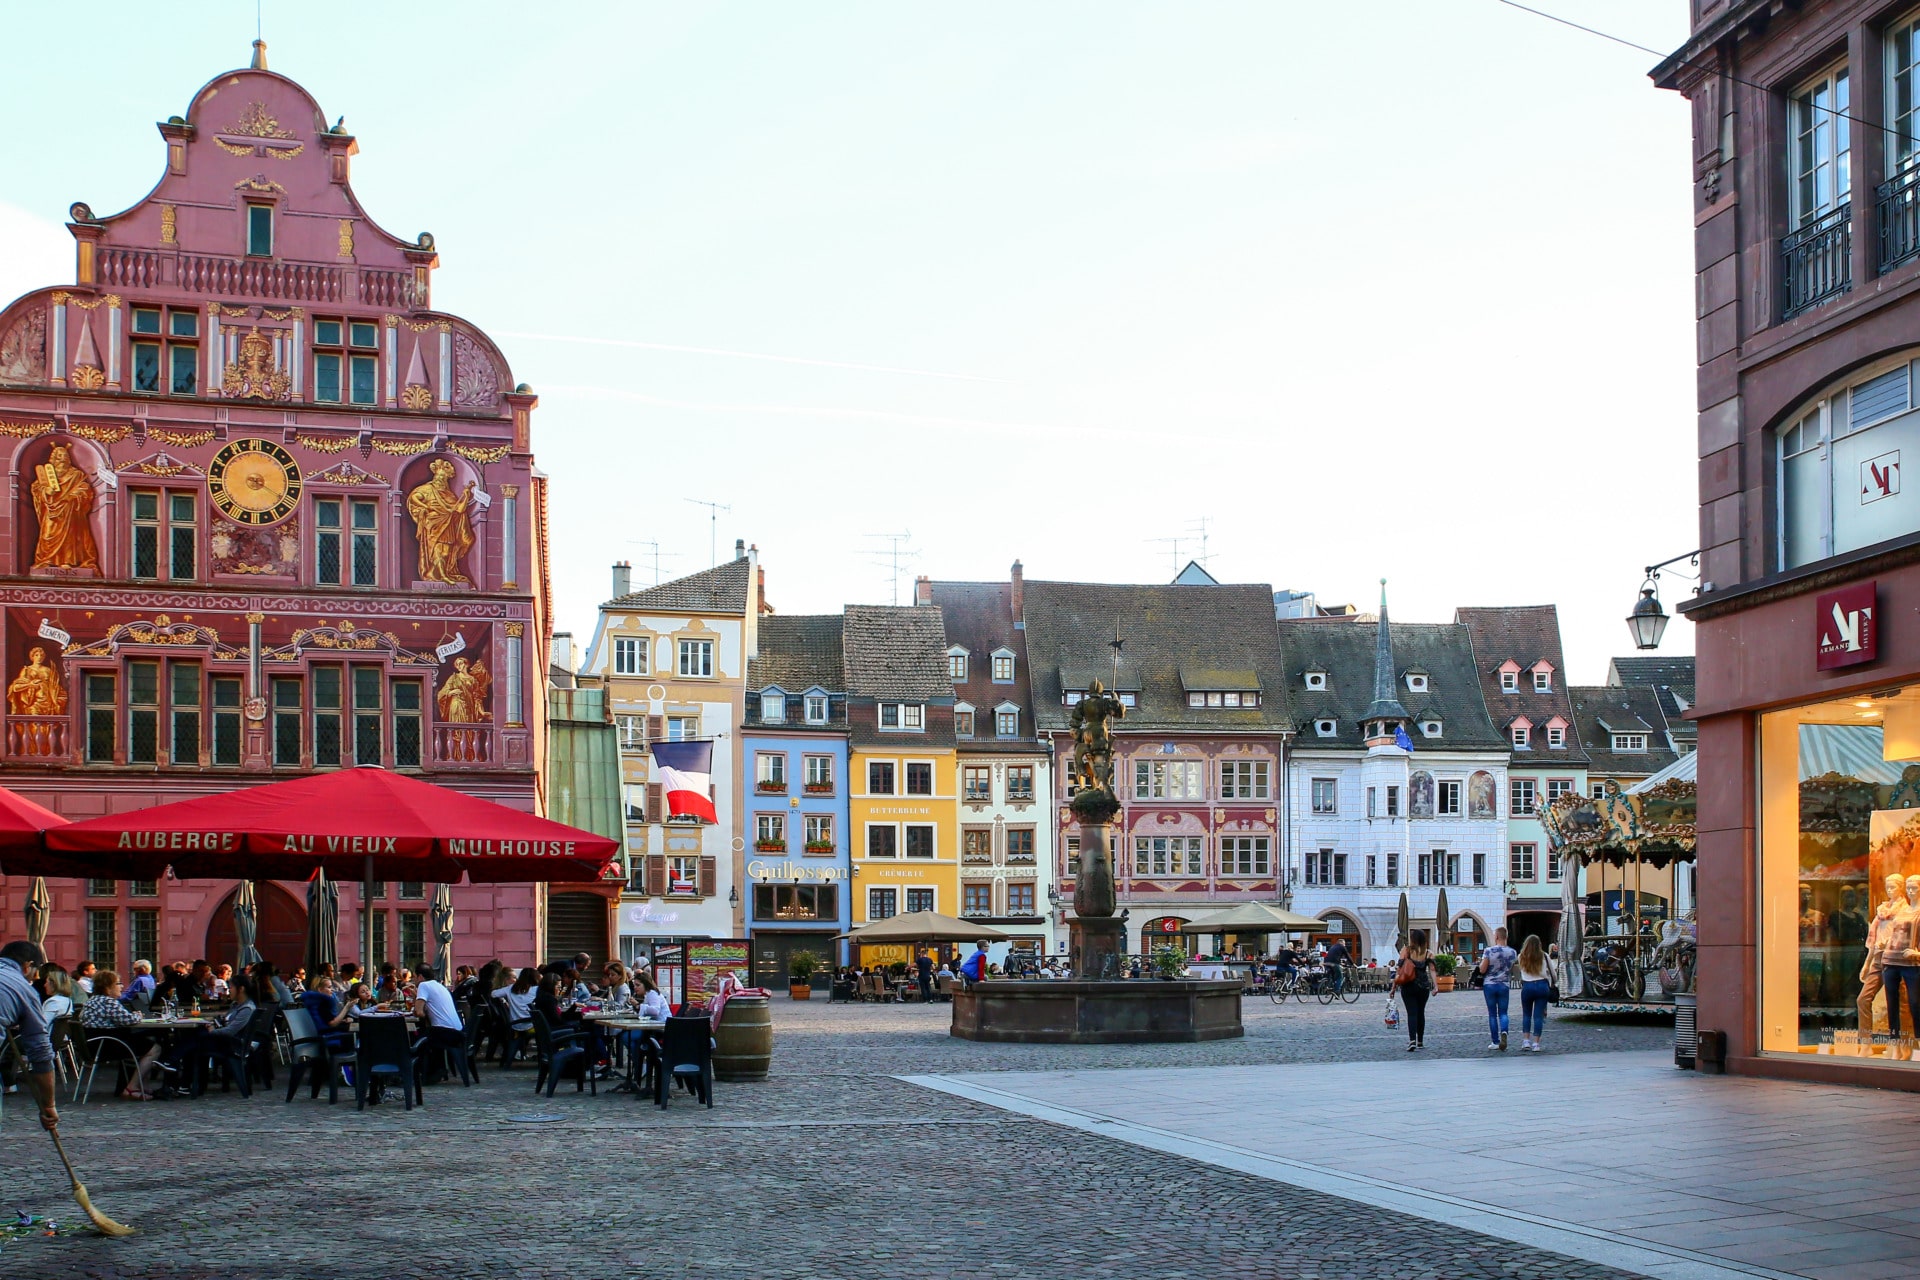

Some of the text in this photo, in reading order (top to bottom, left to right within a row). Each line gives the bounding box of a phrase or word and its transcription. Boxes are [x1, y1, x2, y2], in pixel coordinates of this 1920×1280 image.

[45, 568, 78, 576] MOSES
[1820, 642, 1850, 653] ARMAND
[870, 807, 931, 815] BUTTERBLUME
[117, 831, 234, 850] AUBERGE
[283, 834, 398, 854] AU VIEUX
[449, 838, 576, 856] MULHOUSE
[747, 860, 849, 880] Guillosson
